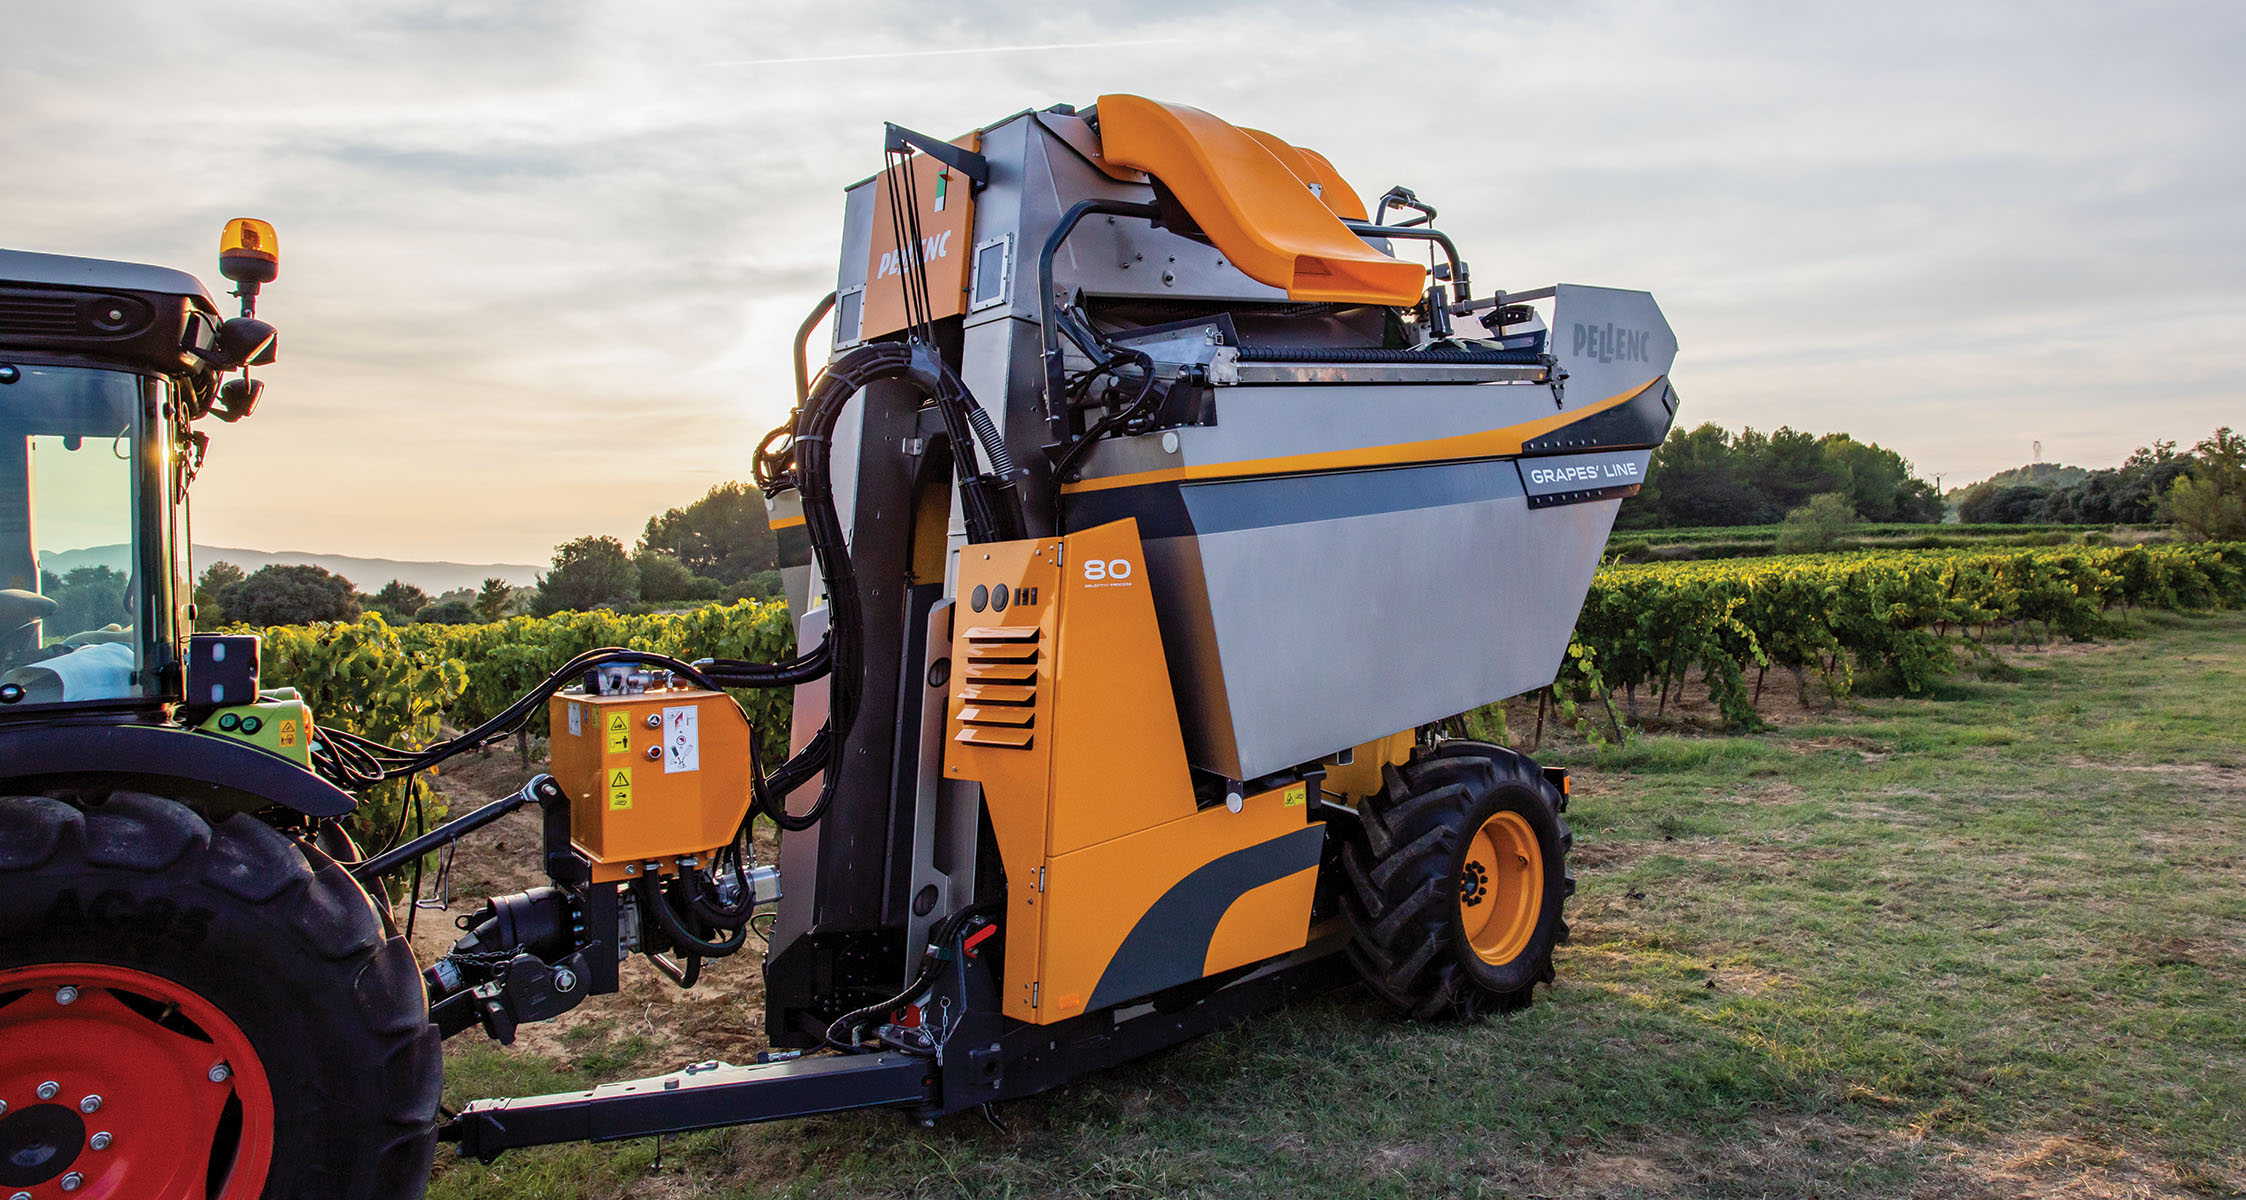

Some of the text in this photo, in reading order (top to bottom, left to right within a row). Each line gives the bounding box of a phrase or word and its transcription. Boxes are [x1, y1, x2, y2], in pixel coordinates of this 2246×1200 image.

[1572, 322, 1650, 364] PELLENC
[1531, 462, 1638, 484] GRAPES' LINE
[1084, 559, 1131, 580] 80
